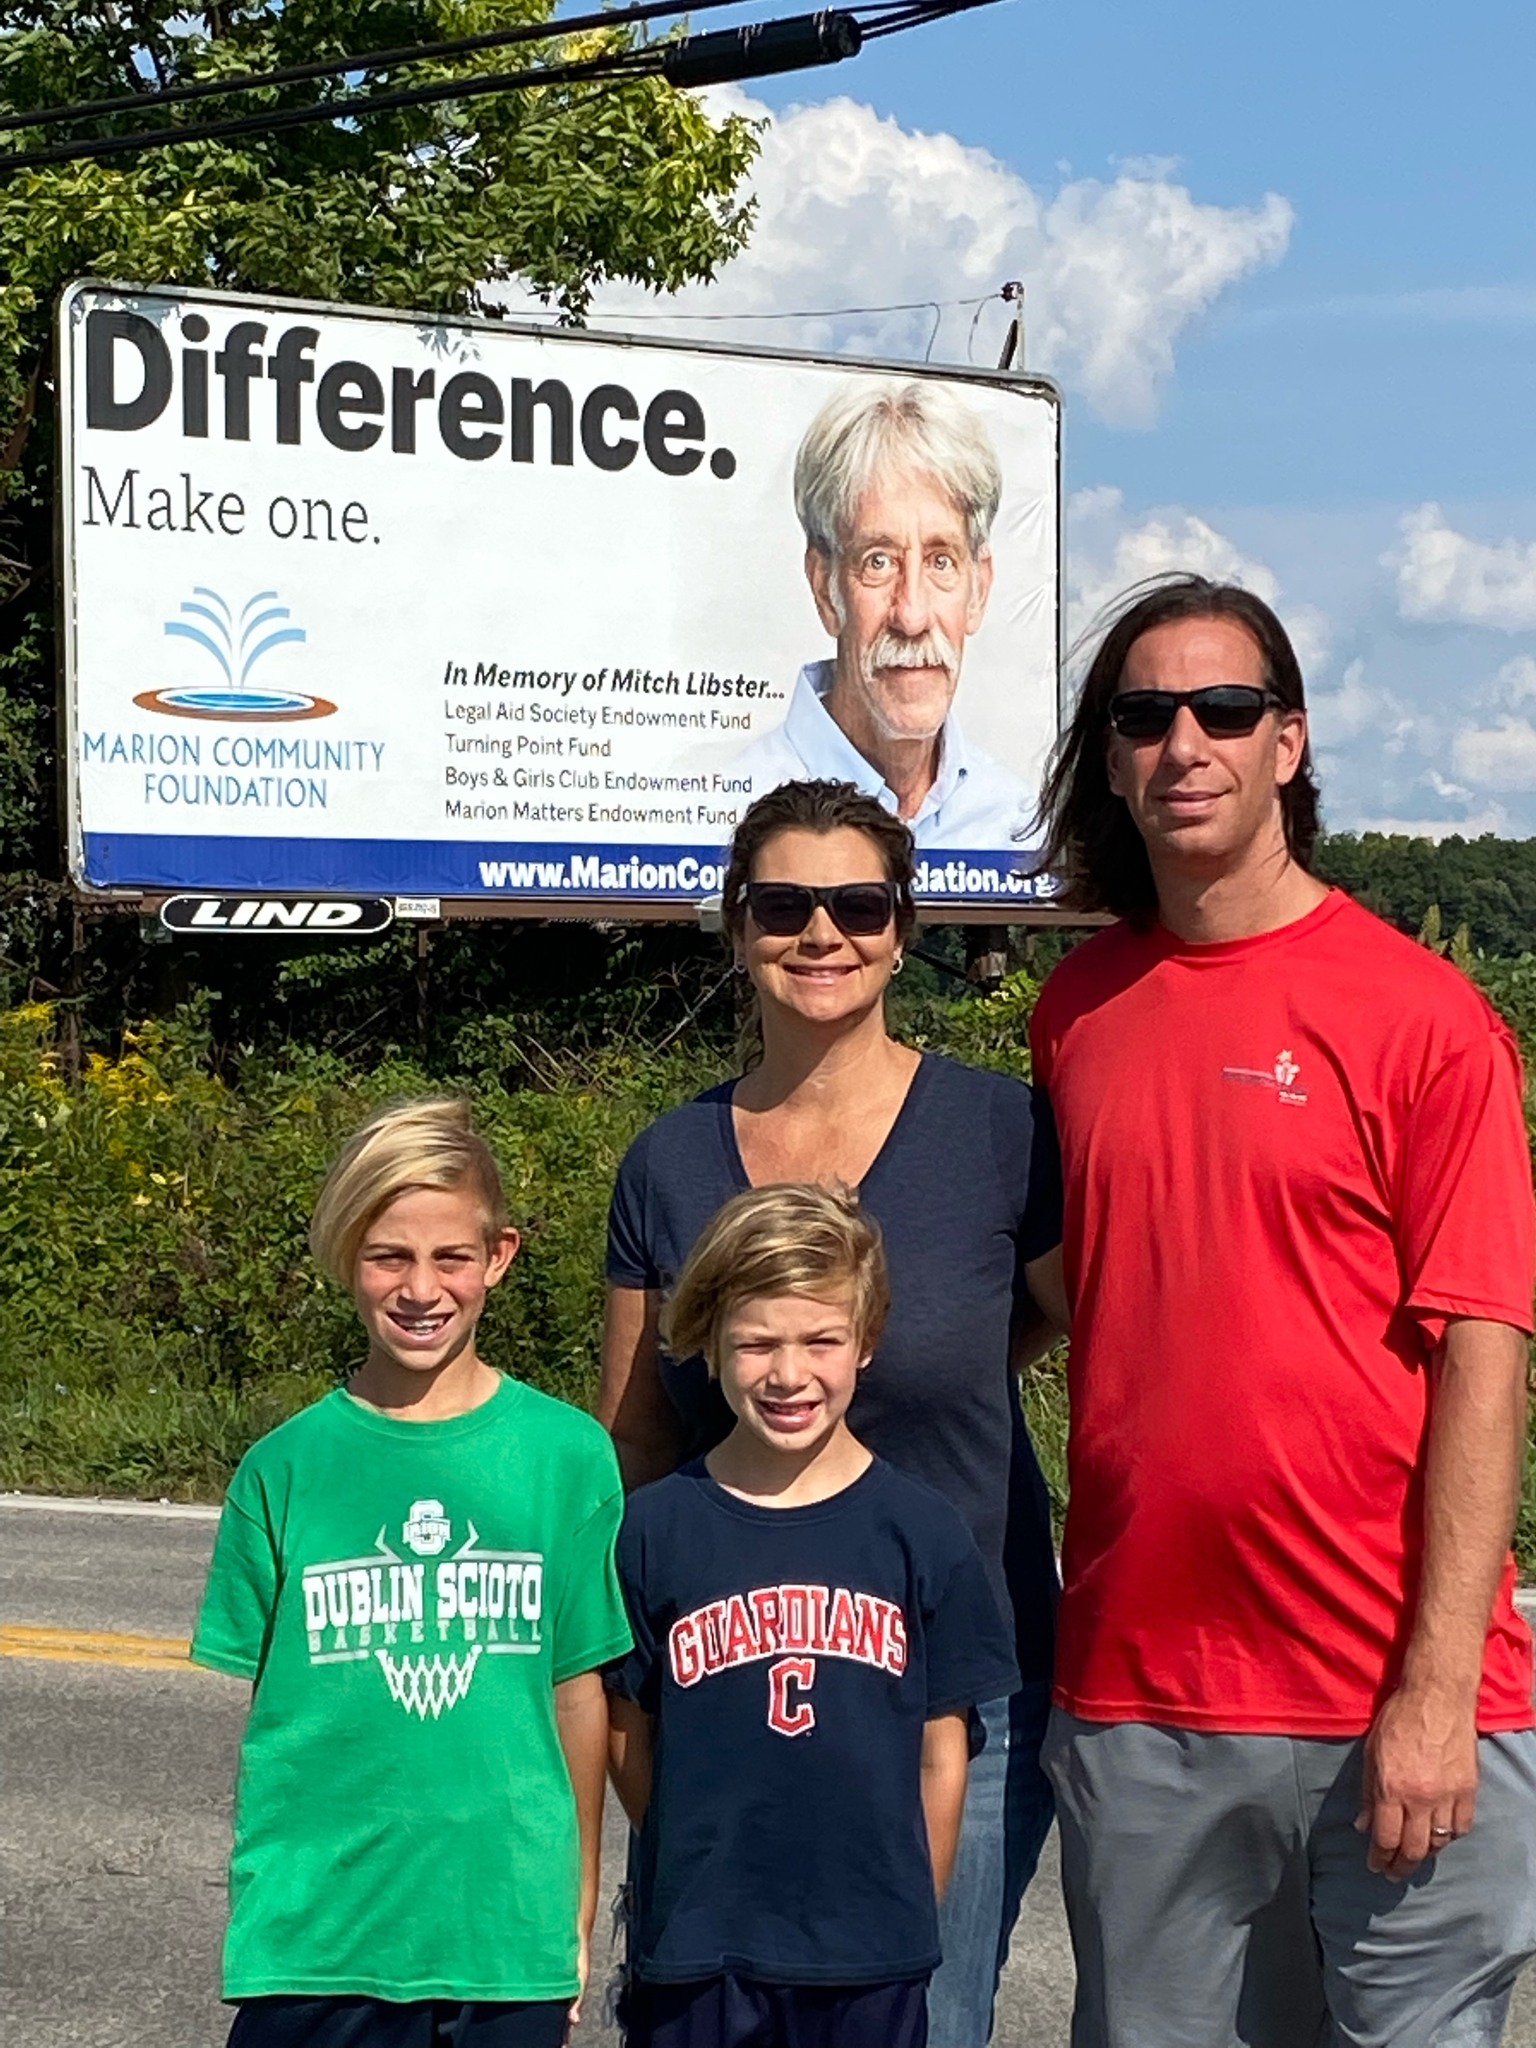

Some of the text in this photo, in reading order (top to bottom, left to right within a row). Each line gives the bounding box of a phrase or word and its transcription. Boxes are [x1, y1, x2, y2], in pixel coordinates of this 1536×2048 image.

[86, 309, 737, 480] Difference.
[81, 465, 382, 545] Make one.
[444, 661, 786, 700] In Memory of Mitch Libster...
[444, 700, 752, 730] Legal Aid Society Endowment Fund
[83, 731, 385, 771] MARION COMMUNITY
[446, 733, 612, 759] Turning Point Fund
[143, 774, 328, 808] FOUNDATION
[446, 766, 753, 794] Boys & Girls Club Endowment Fund
[446, 800, 738, 826] Marion Matters Endowment Fund
[189, 900, 364, 928] LIND
[302, 1561, 543, 1631] DUBLIN SCIOTO
[668, 1584, 908, 1689] GUARDIANS
[767, 1656, 816, 1737] C
